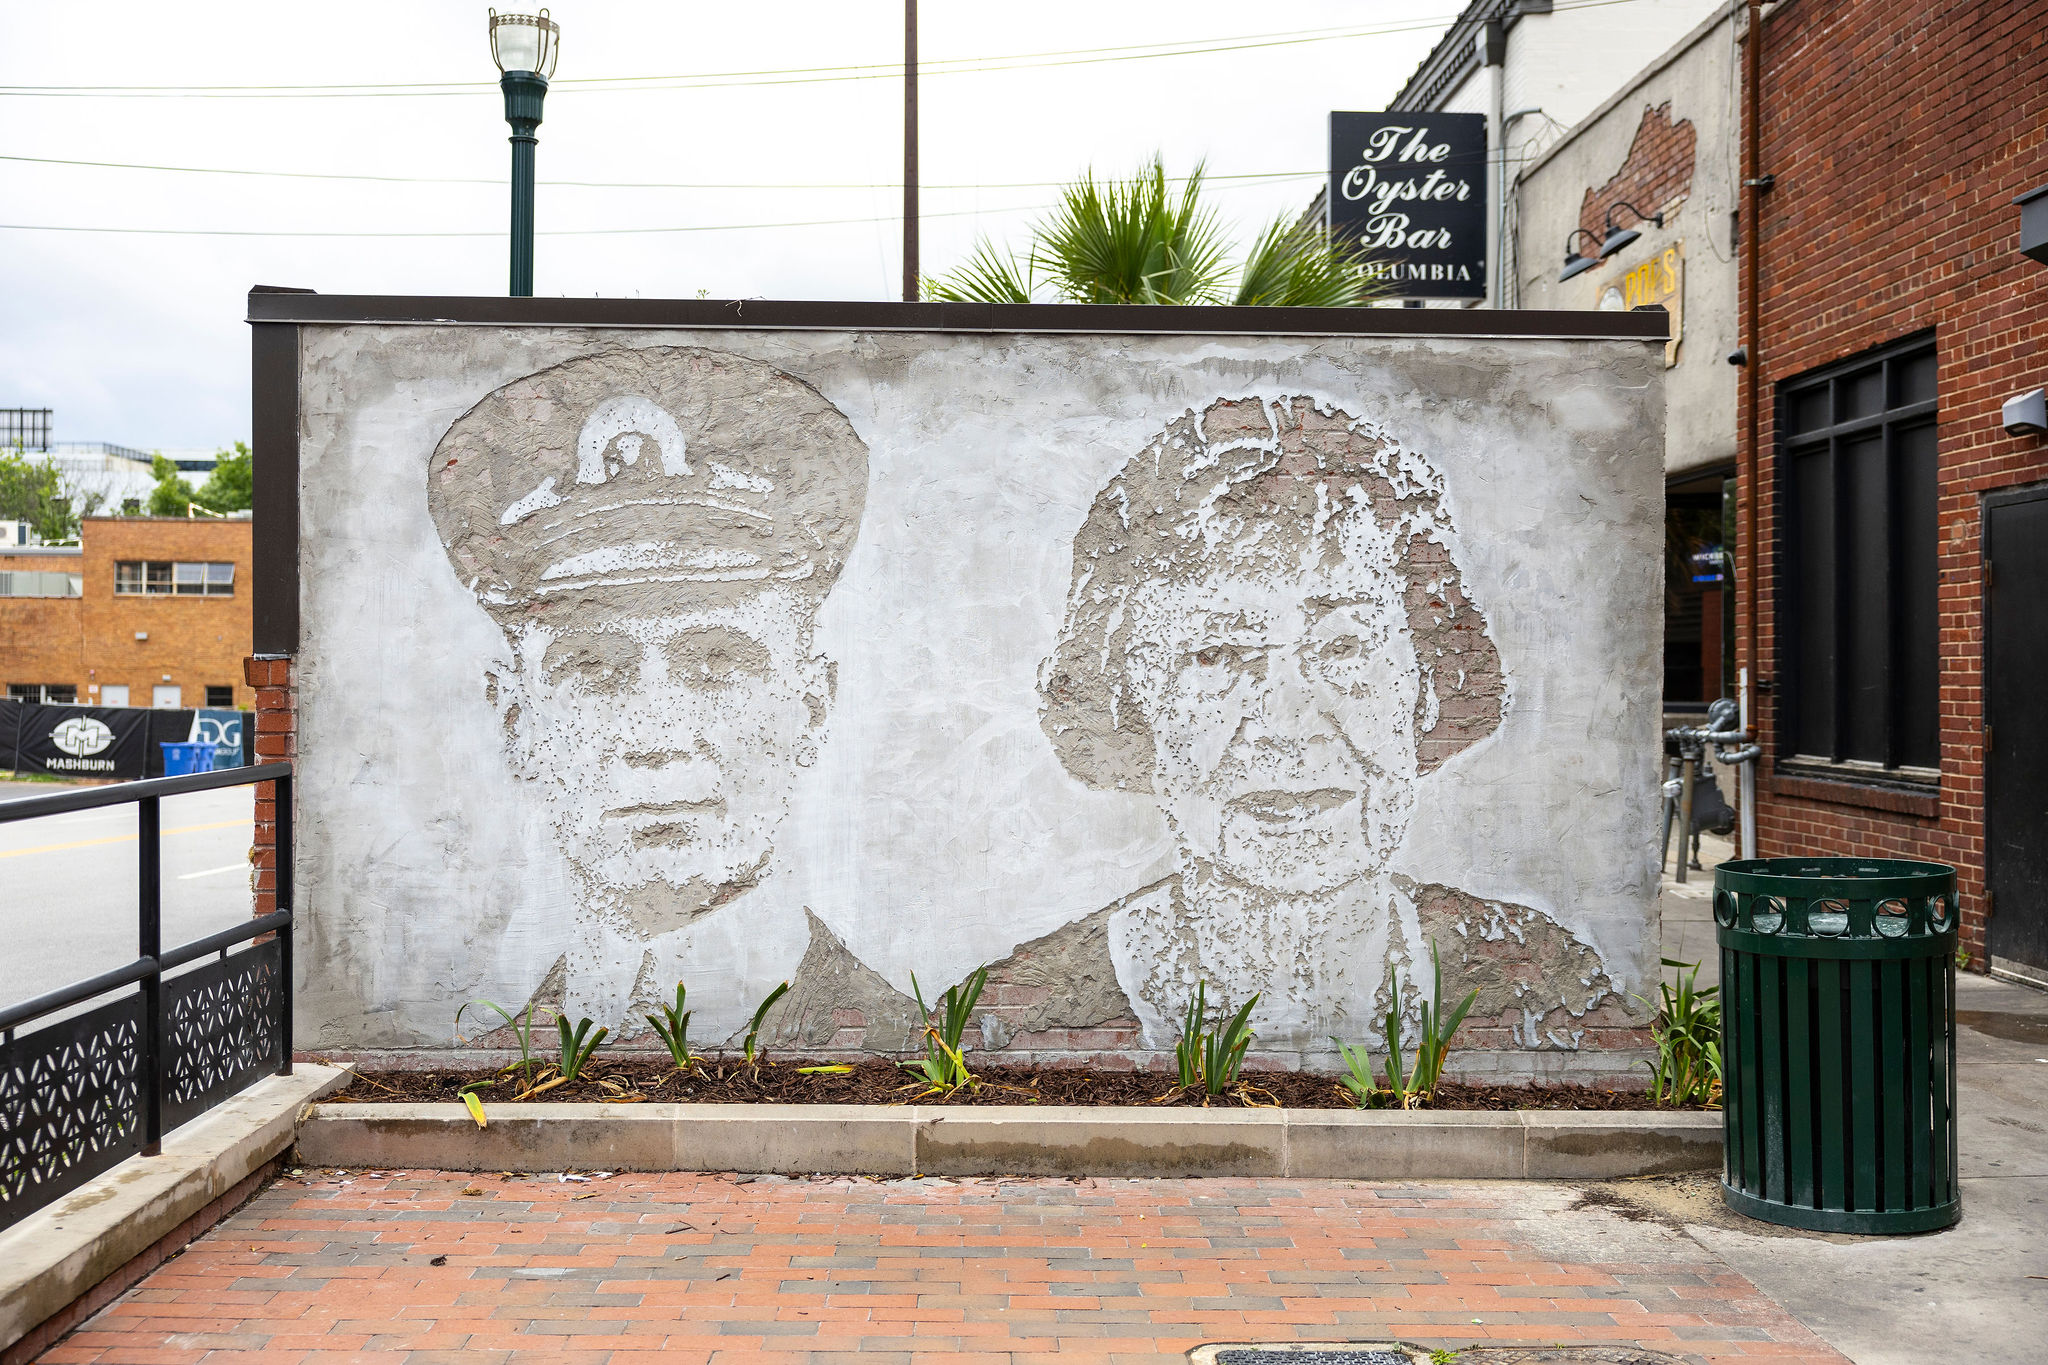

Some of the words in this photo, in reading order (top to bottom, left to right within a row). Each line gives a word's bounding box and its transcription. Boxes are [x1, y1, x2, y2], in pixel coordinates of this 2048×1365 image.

[1362, 125, 1451, 163] The
[1341, 164, 1471, 216] Oyster
[1360, 212, 1452, 249] Bar
[1341, 262, 1471, 281] OLUMBIA
[46, 757, 115, 771] MASHBURN
